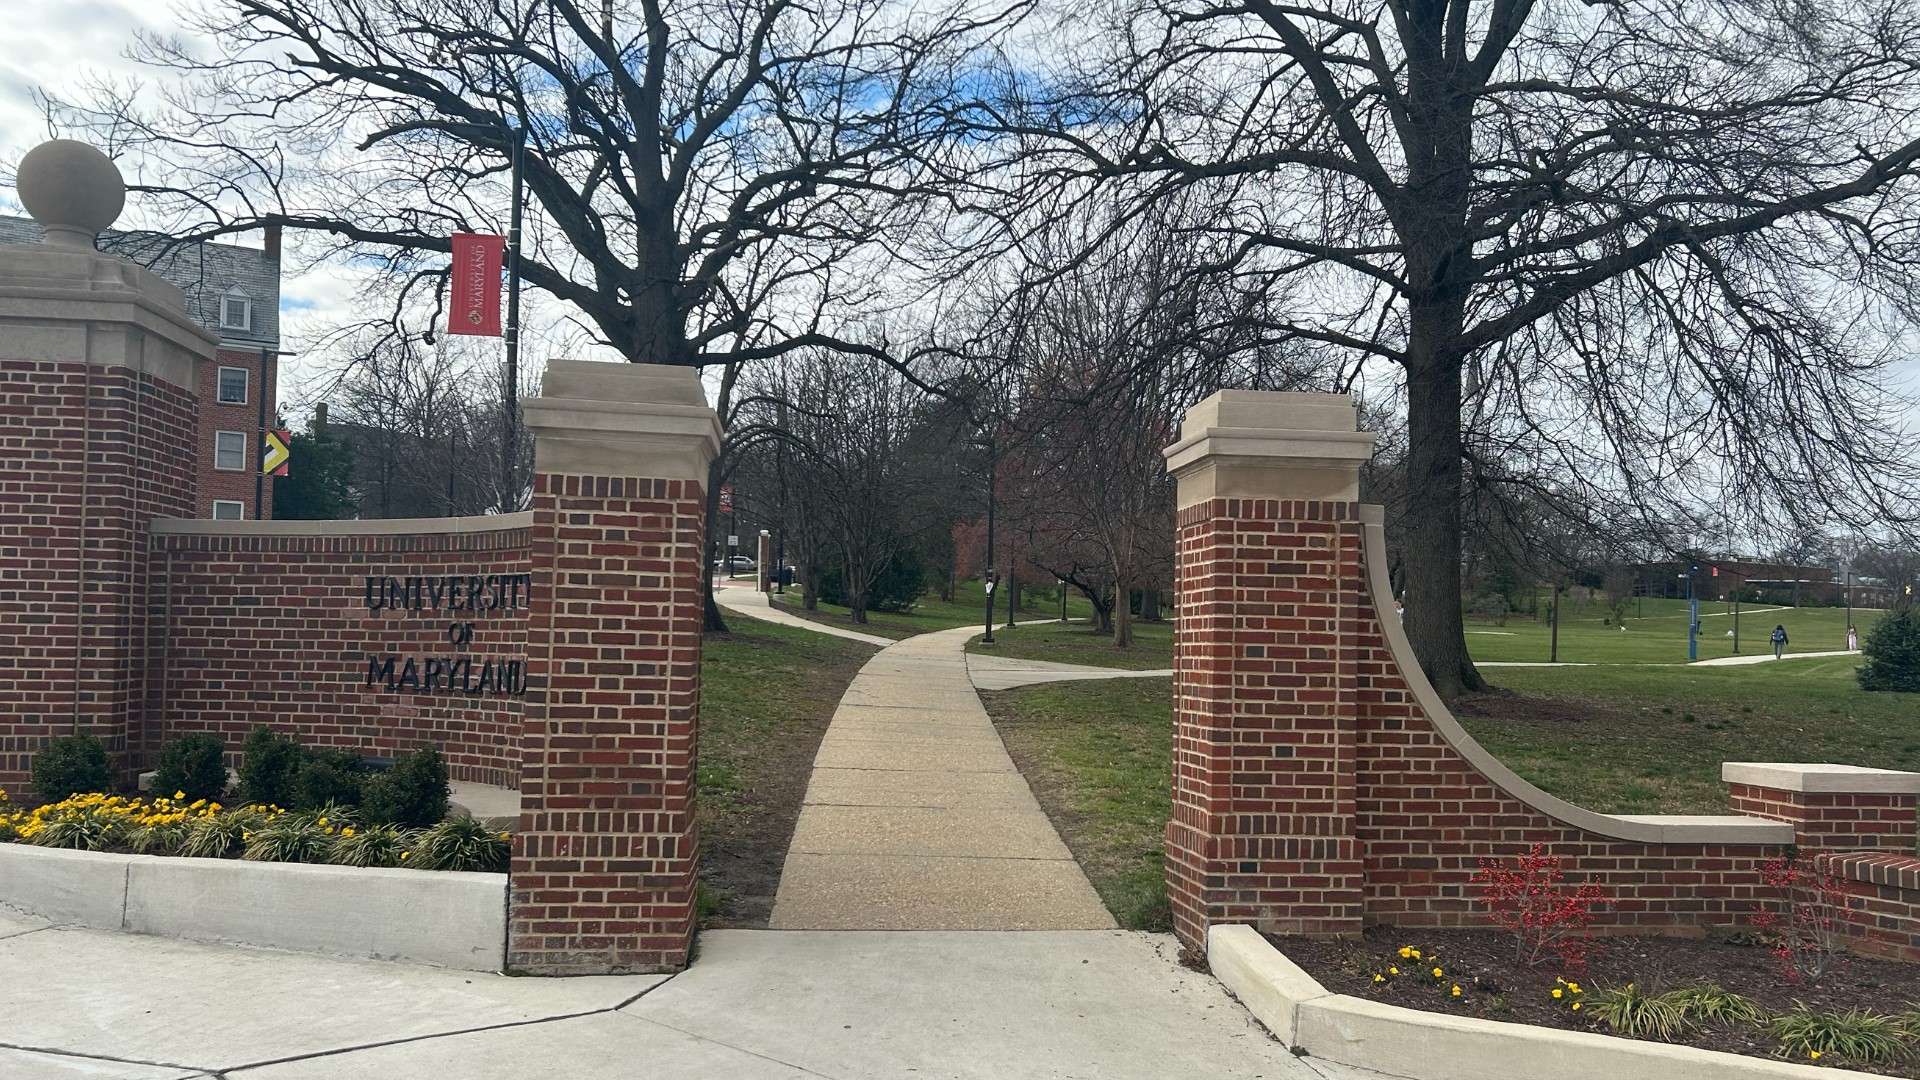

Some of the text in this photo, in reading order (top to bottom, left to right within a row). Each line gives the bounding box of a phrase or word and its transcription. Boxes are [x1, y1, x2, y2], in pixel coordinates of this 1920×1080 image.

[474, 245, 485, 309] MARYLAND
[449, 621, 476, 645] OF
[366, 655, 528, 695] MARYLAND
